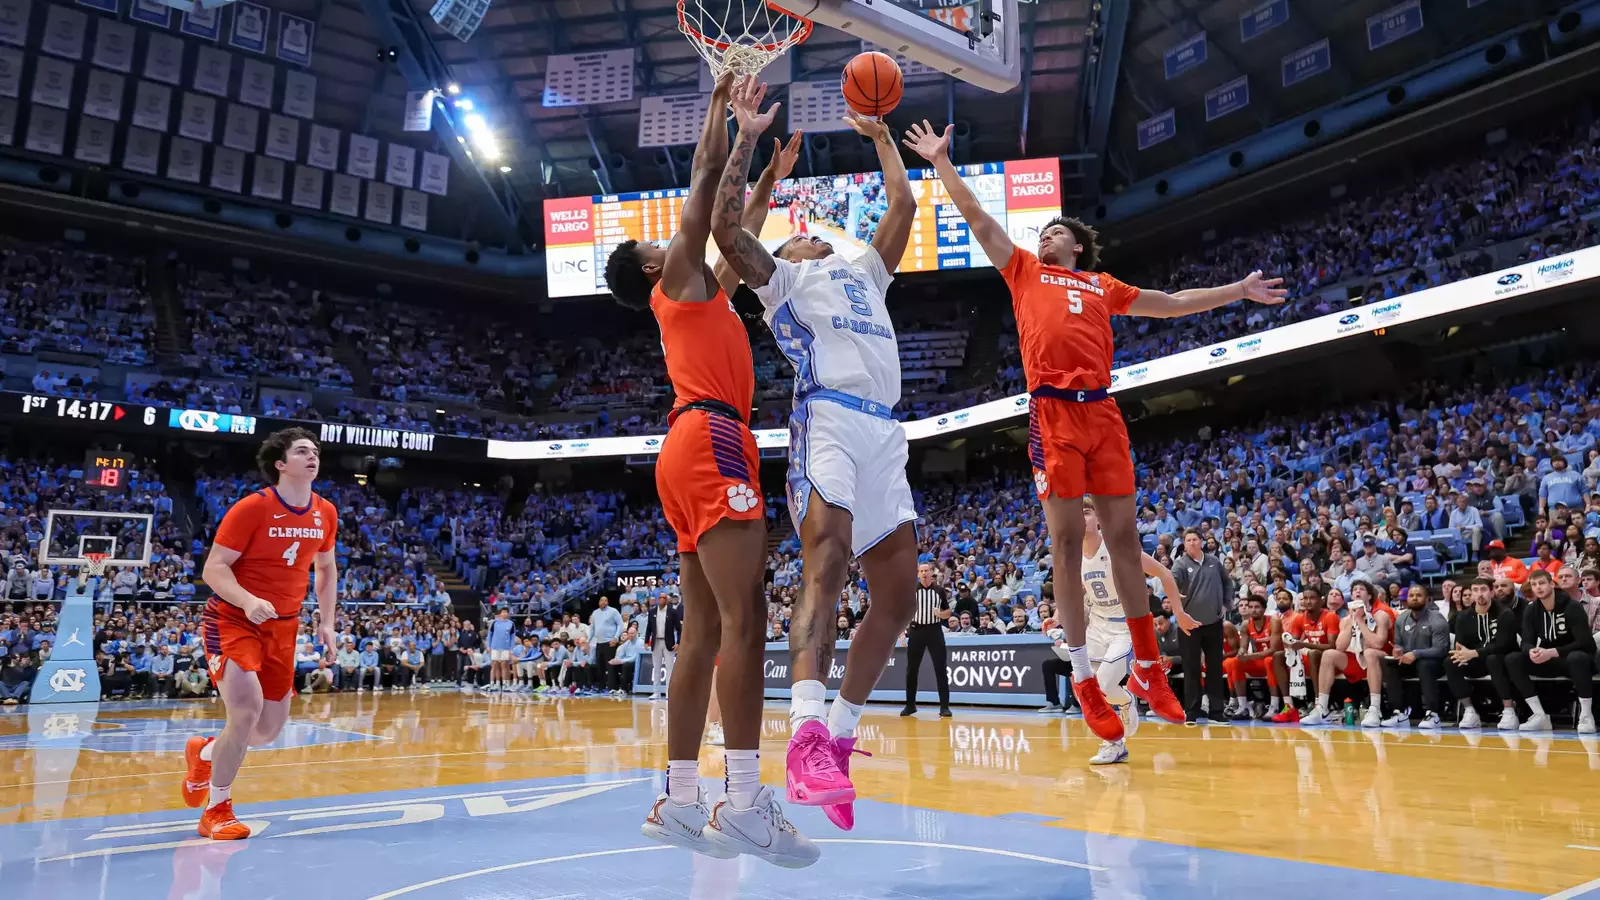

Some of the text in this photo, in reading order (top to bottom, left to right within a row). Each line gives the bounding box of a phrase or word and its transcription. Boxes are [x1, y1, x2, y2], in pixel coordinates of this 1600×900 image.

[921, 168, 941, 179] 14:1
[1010, 171, 1054, 184] WELLS
[1012, 184, 1055, 197] FARGO
[550, 209, 588, 222] WELLS
[551, 221, 589, 233] FARGO
[552, 260, 588, 275] UNC
[1040, 273, 1105, 297] CLEMSON
[1494, 284, 1529, 295] SUBARU
[843, 283, 873, 317] 5
[1066, 289, 1083, 315] 5
[831, 315, 893, 340] CAROLINA
[22, 394, 113, 420] 1ST 14:17
[143, 406, 156, 426] 6
[320, 423, 435, 451] ROY WILLIAMS COURT
[101, 468, 119, 487] 18
[268, 527, 324, 540] CLEMSON
[282, 541, 300, 567] 4
[1090, 580, 1109, 599] 8
[951, 650, 1016, 662] MARRIOTT
[763, 659, 787, 679] Can
